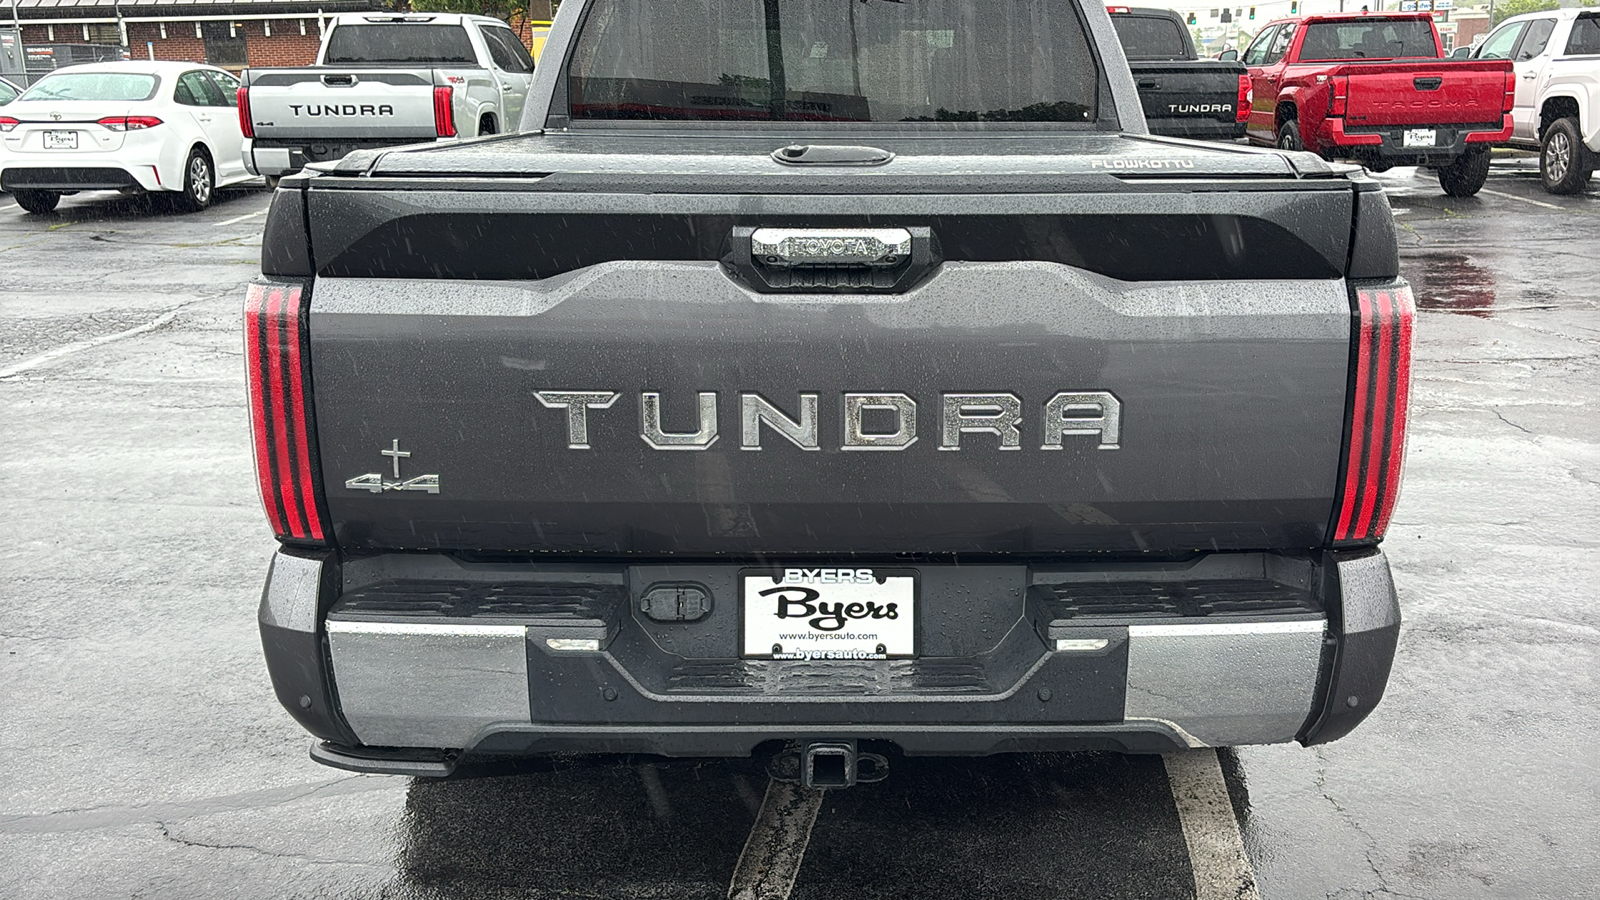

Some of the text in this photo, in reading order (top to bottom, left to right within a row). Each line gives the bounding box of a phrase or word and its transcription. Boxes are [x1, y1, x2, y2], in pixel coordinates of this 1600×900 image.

[288, 104, 394, 116] TUNDRA
[1168, 104, 1232, 113] TUNDRA
[1373, 100, 1478, 109] TACOMA
[1091, 159, 1194, 169] FLOWKOTTU
[800, 239, 867, 254] TOYOTA
[533, 391, 1121, 450] TUNDRA
[345, 473, 440, 494] 4x4
[784, 569, 873, 584] BYERS
[758, 586, 898, 631] Byers
[779, 631, 878, 642] www.byersauto.com
[773, 647, 887, 661] www.byersauto.com
